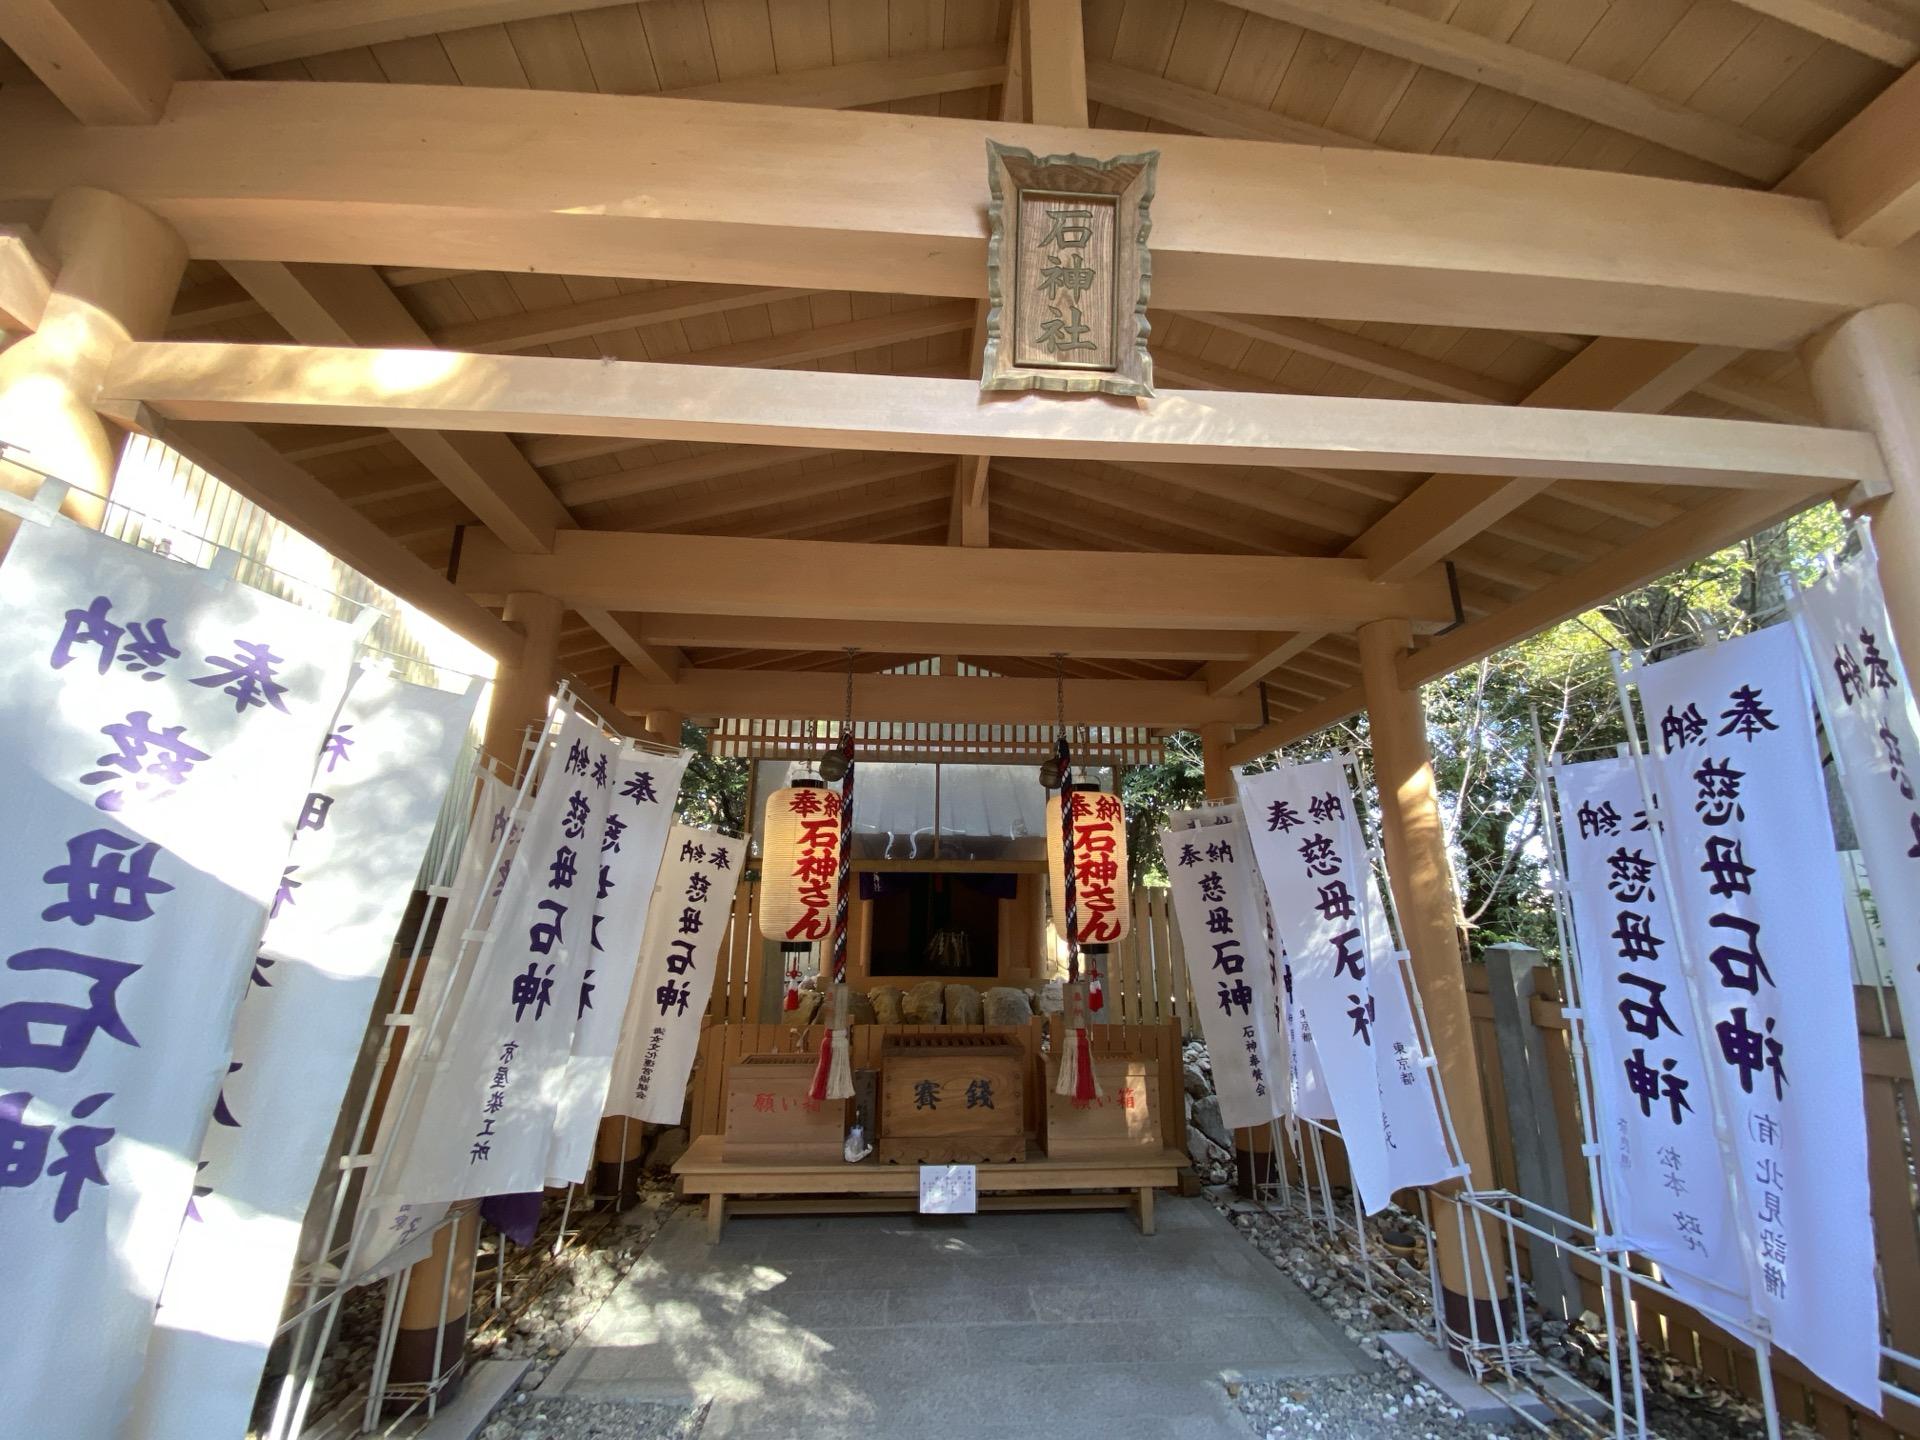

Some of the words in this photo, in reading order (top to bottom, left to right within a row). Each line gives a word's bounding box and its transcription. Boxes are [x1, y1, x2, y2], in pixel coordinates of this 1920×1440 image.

[1036, 209, 1097, 354] 石神社
[788, 791, 843, 819] 奉納
[1069, 794, 1122, 821] 奉納
[1266, 791, 1346, 834] 奉納
[1178, 840, 1234, 868] 奉納
[786, 818, 840, 941] 石神さん
[1072, 822, 1123, 942] 石神さん
[1198, 871, 1253, 1017] 慈母石神
[1392, 1041, 1416, 1087] 東京都
